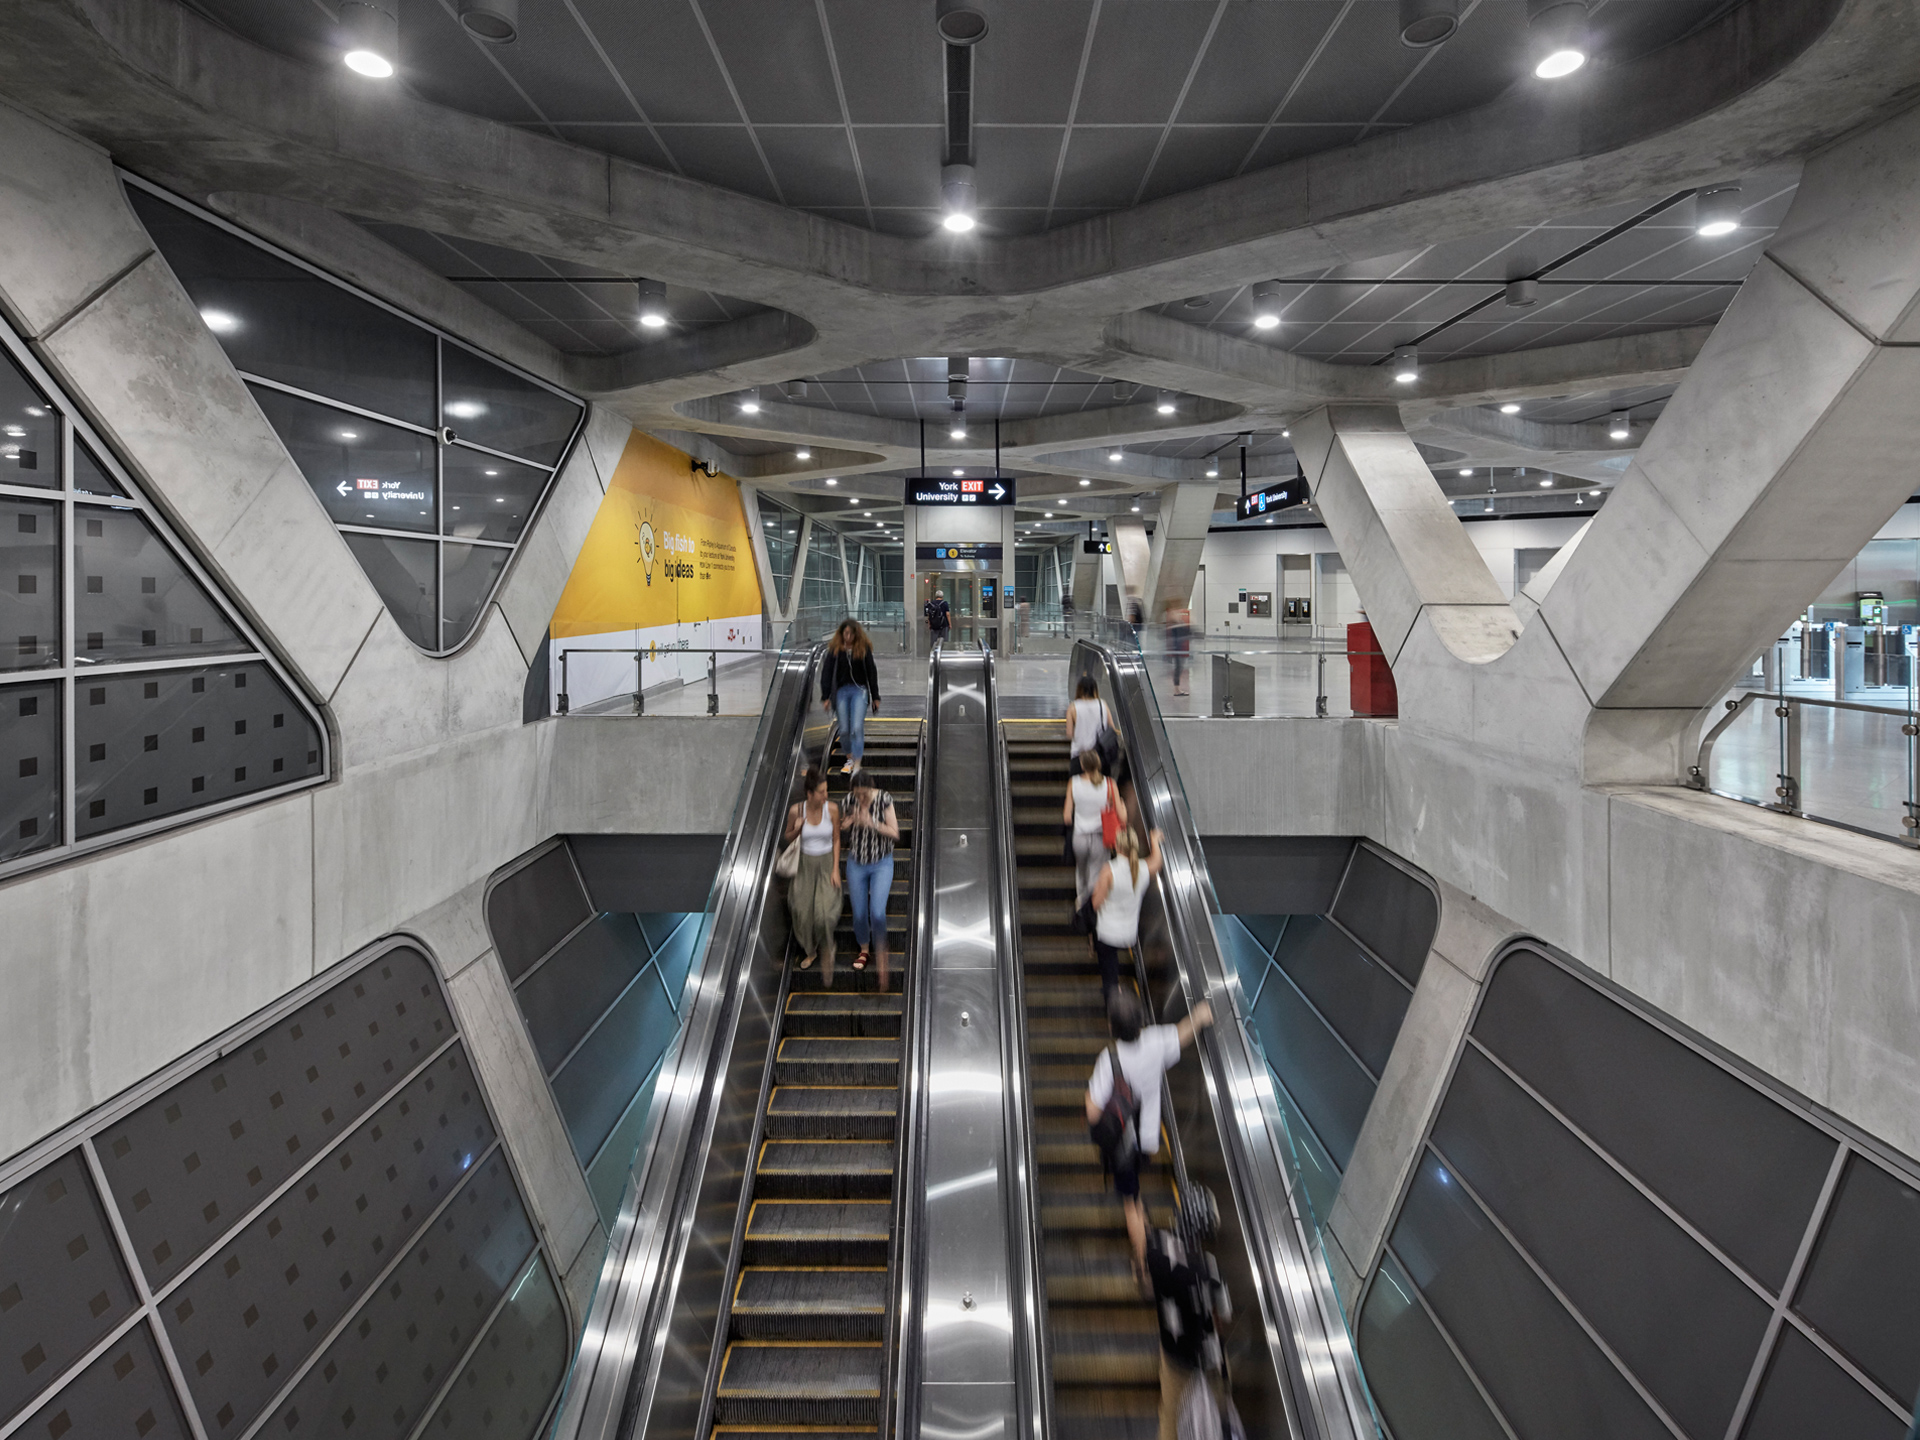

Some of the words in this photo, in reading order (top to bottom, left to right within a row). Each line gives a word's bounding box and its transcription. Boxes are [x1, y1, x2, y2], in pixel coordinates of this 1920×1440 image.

[939, 482, 958, 490] York
[962, 481, 983, 491] EXIT
[916, 492, 959, 503] University
[663, 531, 675, 556] Big
[675, 533, 688, 553] fish
[688, 537, 695, 553] to
[664, 559, 675, 583] big
[675, 558, 694, 579] ideas
